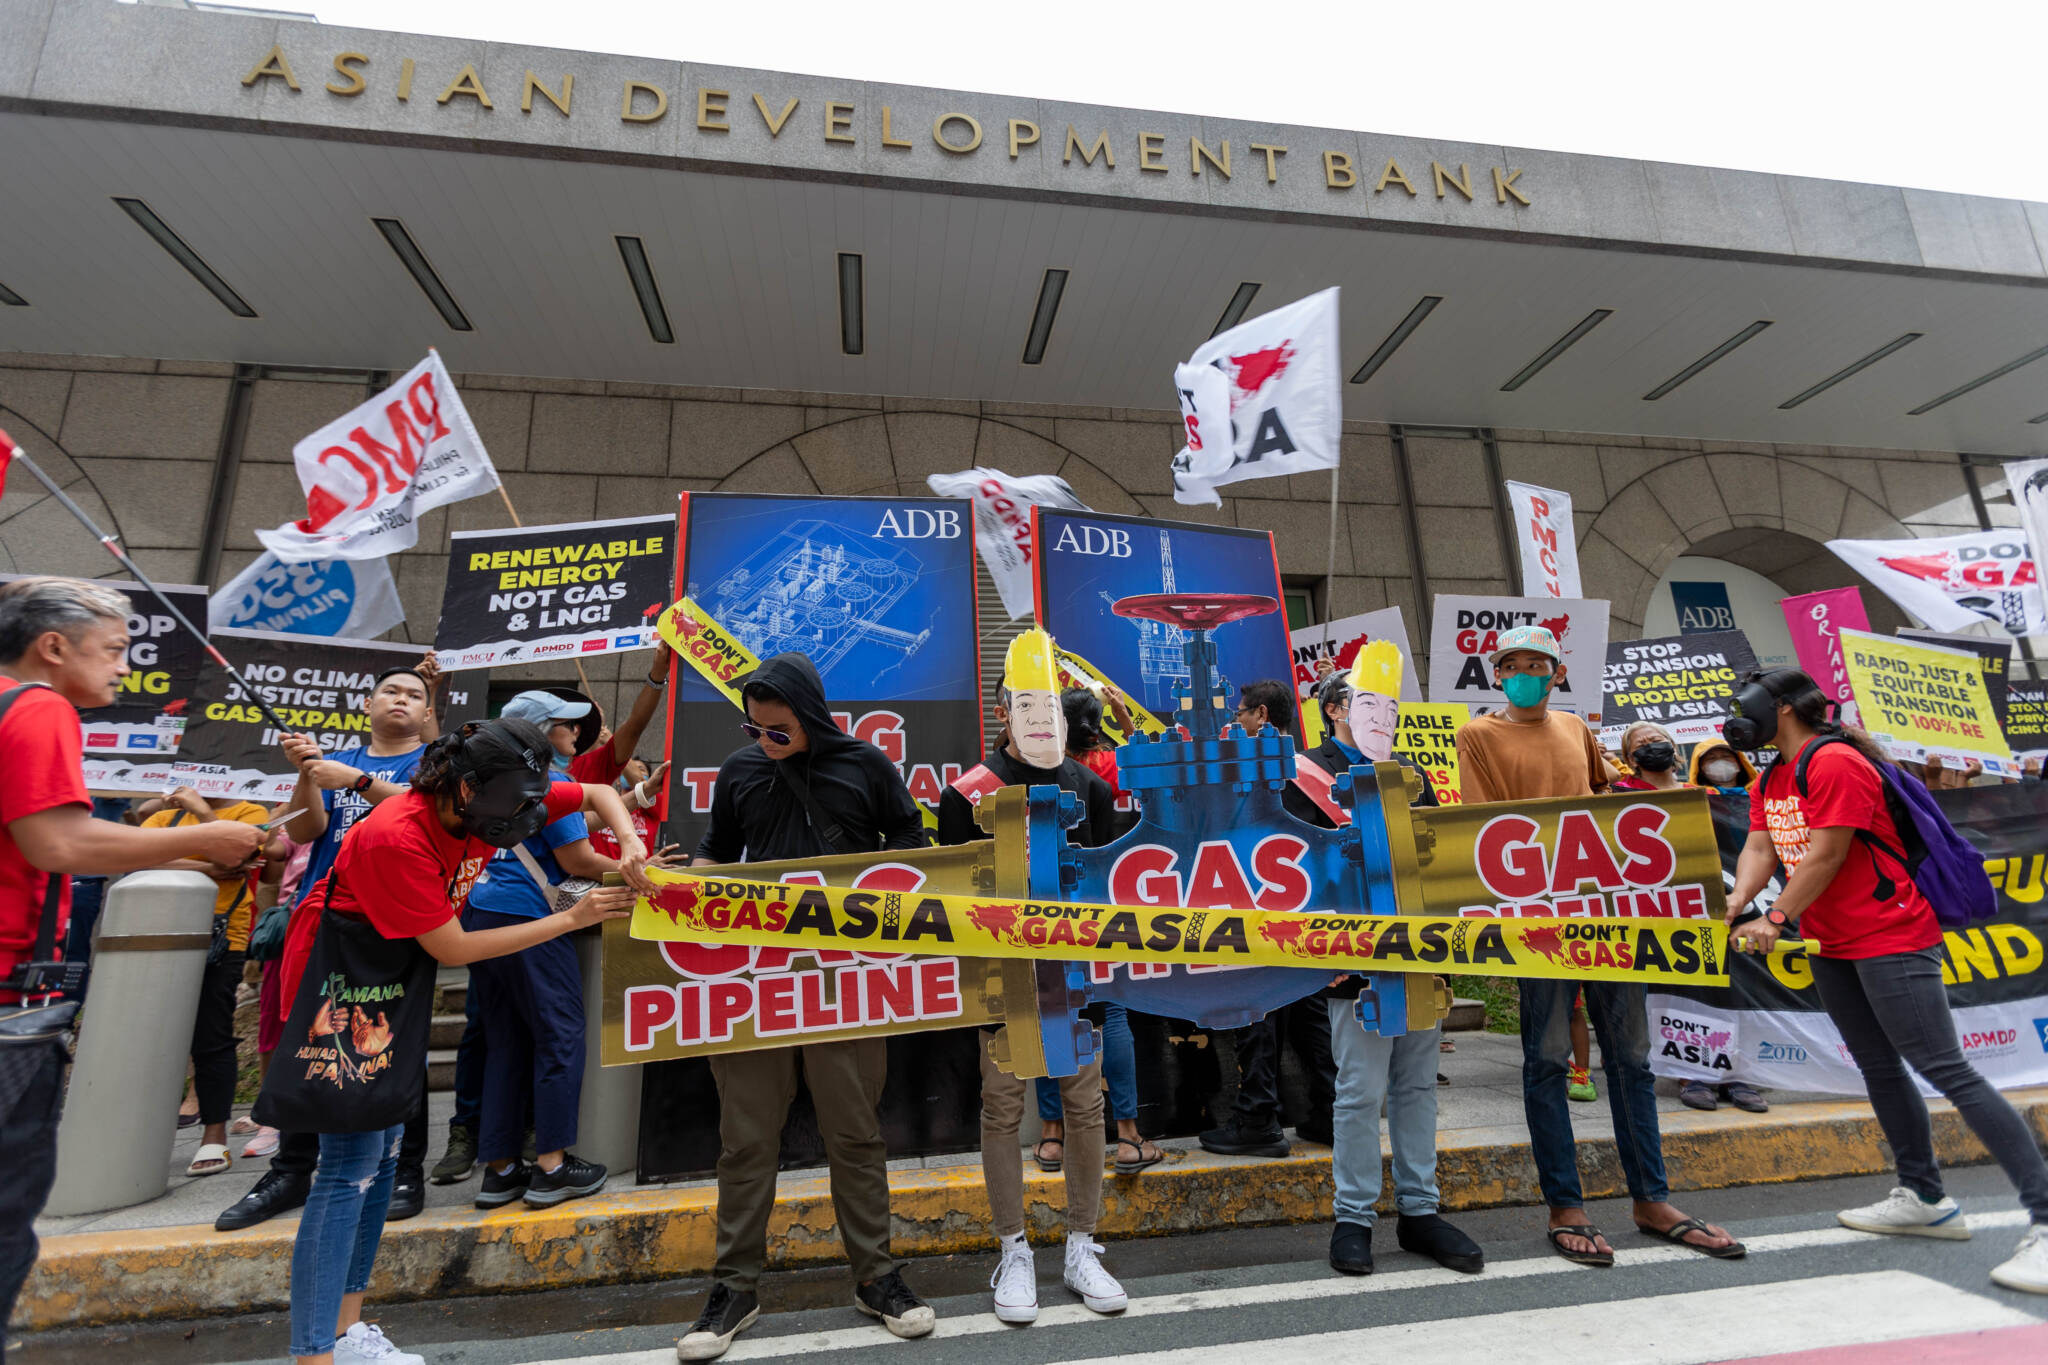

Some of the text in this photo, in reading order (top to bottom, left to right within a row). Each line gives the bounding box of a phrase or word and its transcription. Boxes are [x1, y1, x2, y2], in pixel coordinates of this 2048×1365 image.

[241, 44, 1531, 206] ASIAN DEVELOPMENT BANK
[872, 508, 962, 539] ADB
[469, 537, 663, 571] RENEWABLE
[1053, 523, 1132, 558] ADB
[499, 561, 624, 590] ENERGY
[1962, 561, 2038, 588] GA
[489, 582, 627, 612] NOT GAS
[507, 604, 612, 632] & LNG!
[1457, 610, 1537, 631] DON'T
[1681, 607, 1733, 629] ADB
[533, 643, 574, 654] APMDD
[701, 628, 749, 669] DON'T
[1456, 629, 1499, 654] GA
[1623, 643, 1682, 661] STOP
[690, 640, 738, 681] GAS
[1602, 653, 1728, 679] EXPANSION
[1854, 652, 1916, 679] RAPID,
[1918, 664, 1959, 684] JUST
[1965, 672, 1978, 686] &
[244, 664, 376, 690] NO CLIMA
[1602, 667, 1736, 694] OF GAS/LNG
[1872, 673, 1971, 702] EQUITABLE
[1614, 684, 1733, 707] PROJECTS
[1870, 690, 1978, 721] TRANSITION
[205, 703, 373, 732] GAS EXPANS
[1636, 700, 1726, 721] IN ASIA
[1881, 709, 1985, 739] TO 100% RE
[1408, 734, 1457, 748] IS TH
[1474, 803, 1676, 903] GAS
[1108, 833, 1312, 912] GAS
[704, 881, 790, 902] DON'T
[703, 889, 954, 942] GAS ASIA
[1023, 904, 1105, 920] DON'T
[1309, 918, 1384, 932] DON'T
[1021, 911, 1250, 953] GAS ASIA
[1305, 920, 1517, 965] GAS ASIA
[1565, 923, 1629, 942] DON'T
[1569, 941, 1634, 969] GAS
[1633, 926, 1731, 975] ASI
[625, 957, 963, 1051] PIPELINE
[1660, 1027, 1702, 1047] GAS
[1661, 1016, 1710, 1035] DON'T
[1962, 1029, 2017, 1049] APMDD
[295, 1046, 338, 1061] HUWAG
[1661, 1041, 1733, 1070] ASIA
